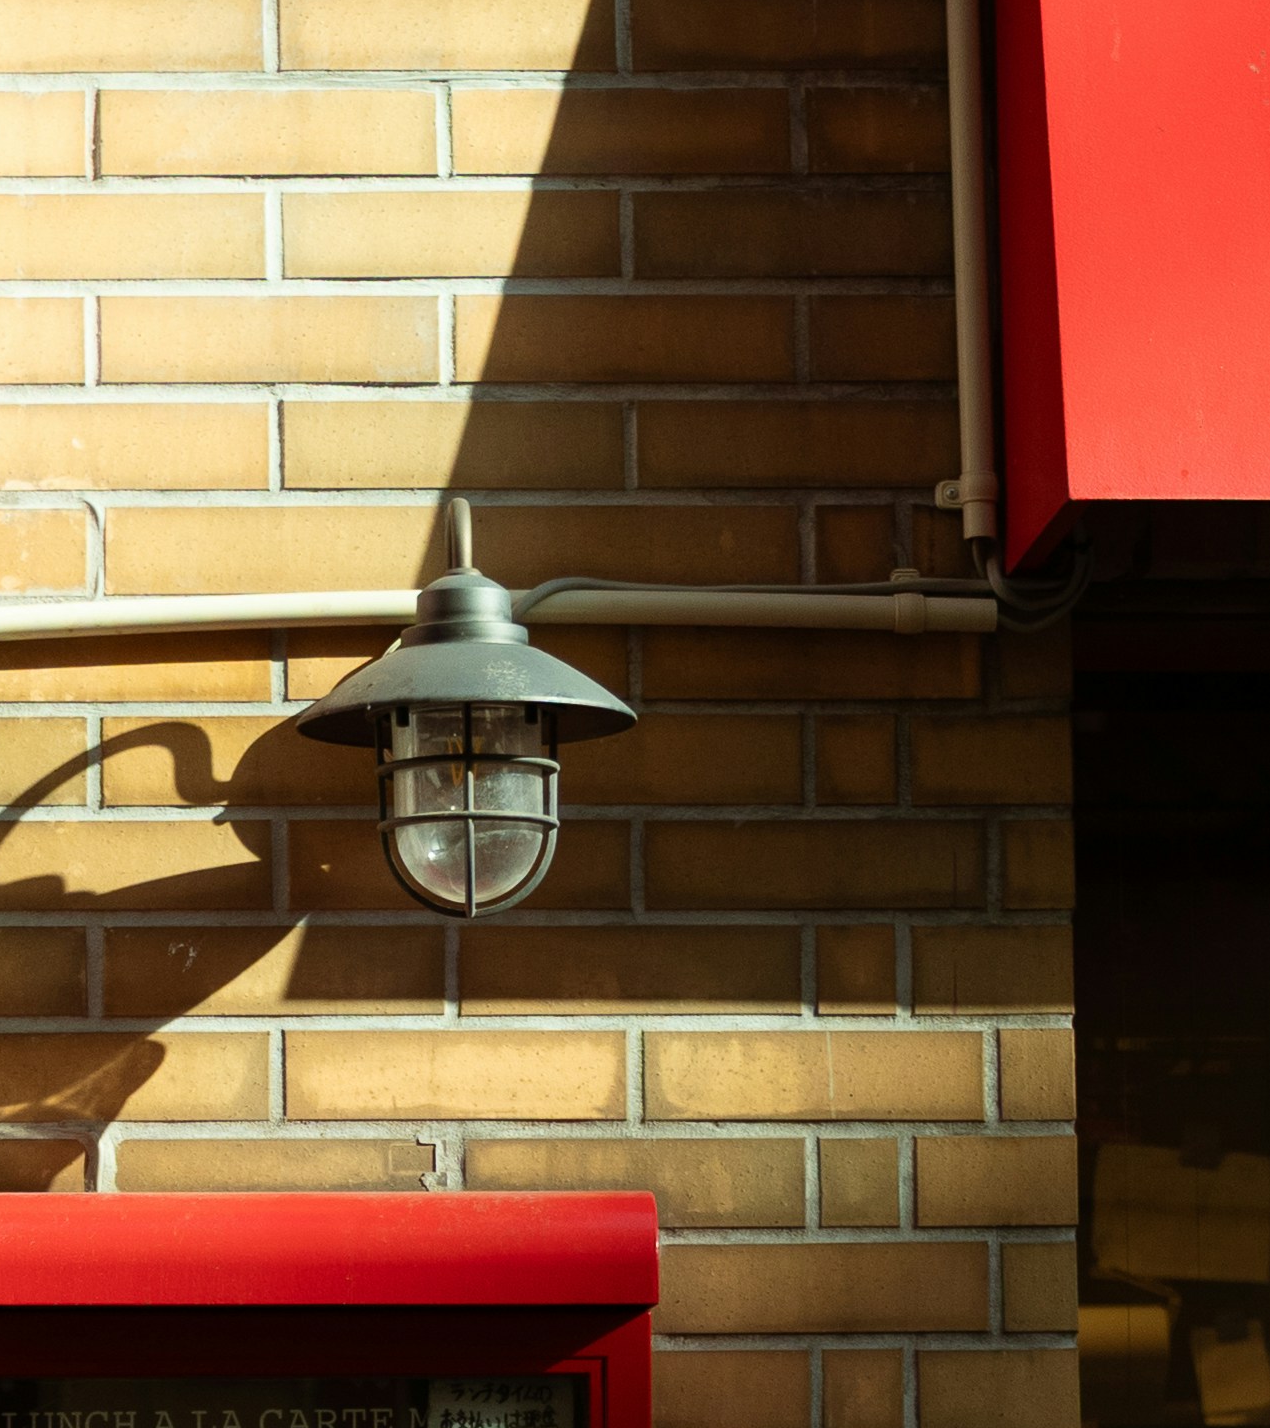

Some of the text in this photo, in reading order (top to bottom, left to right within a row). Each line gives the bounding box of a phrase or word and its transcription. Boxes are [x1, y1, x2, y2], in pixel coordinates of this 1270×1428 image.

[451, 1383, 553, 1403] ランチタイムの
